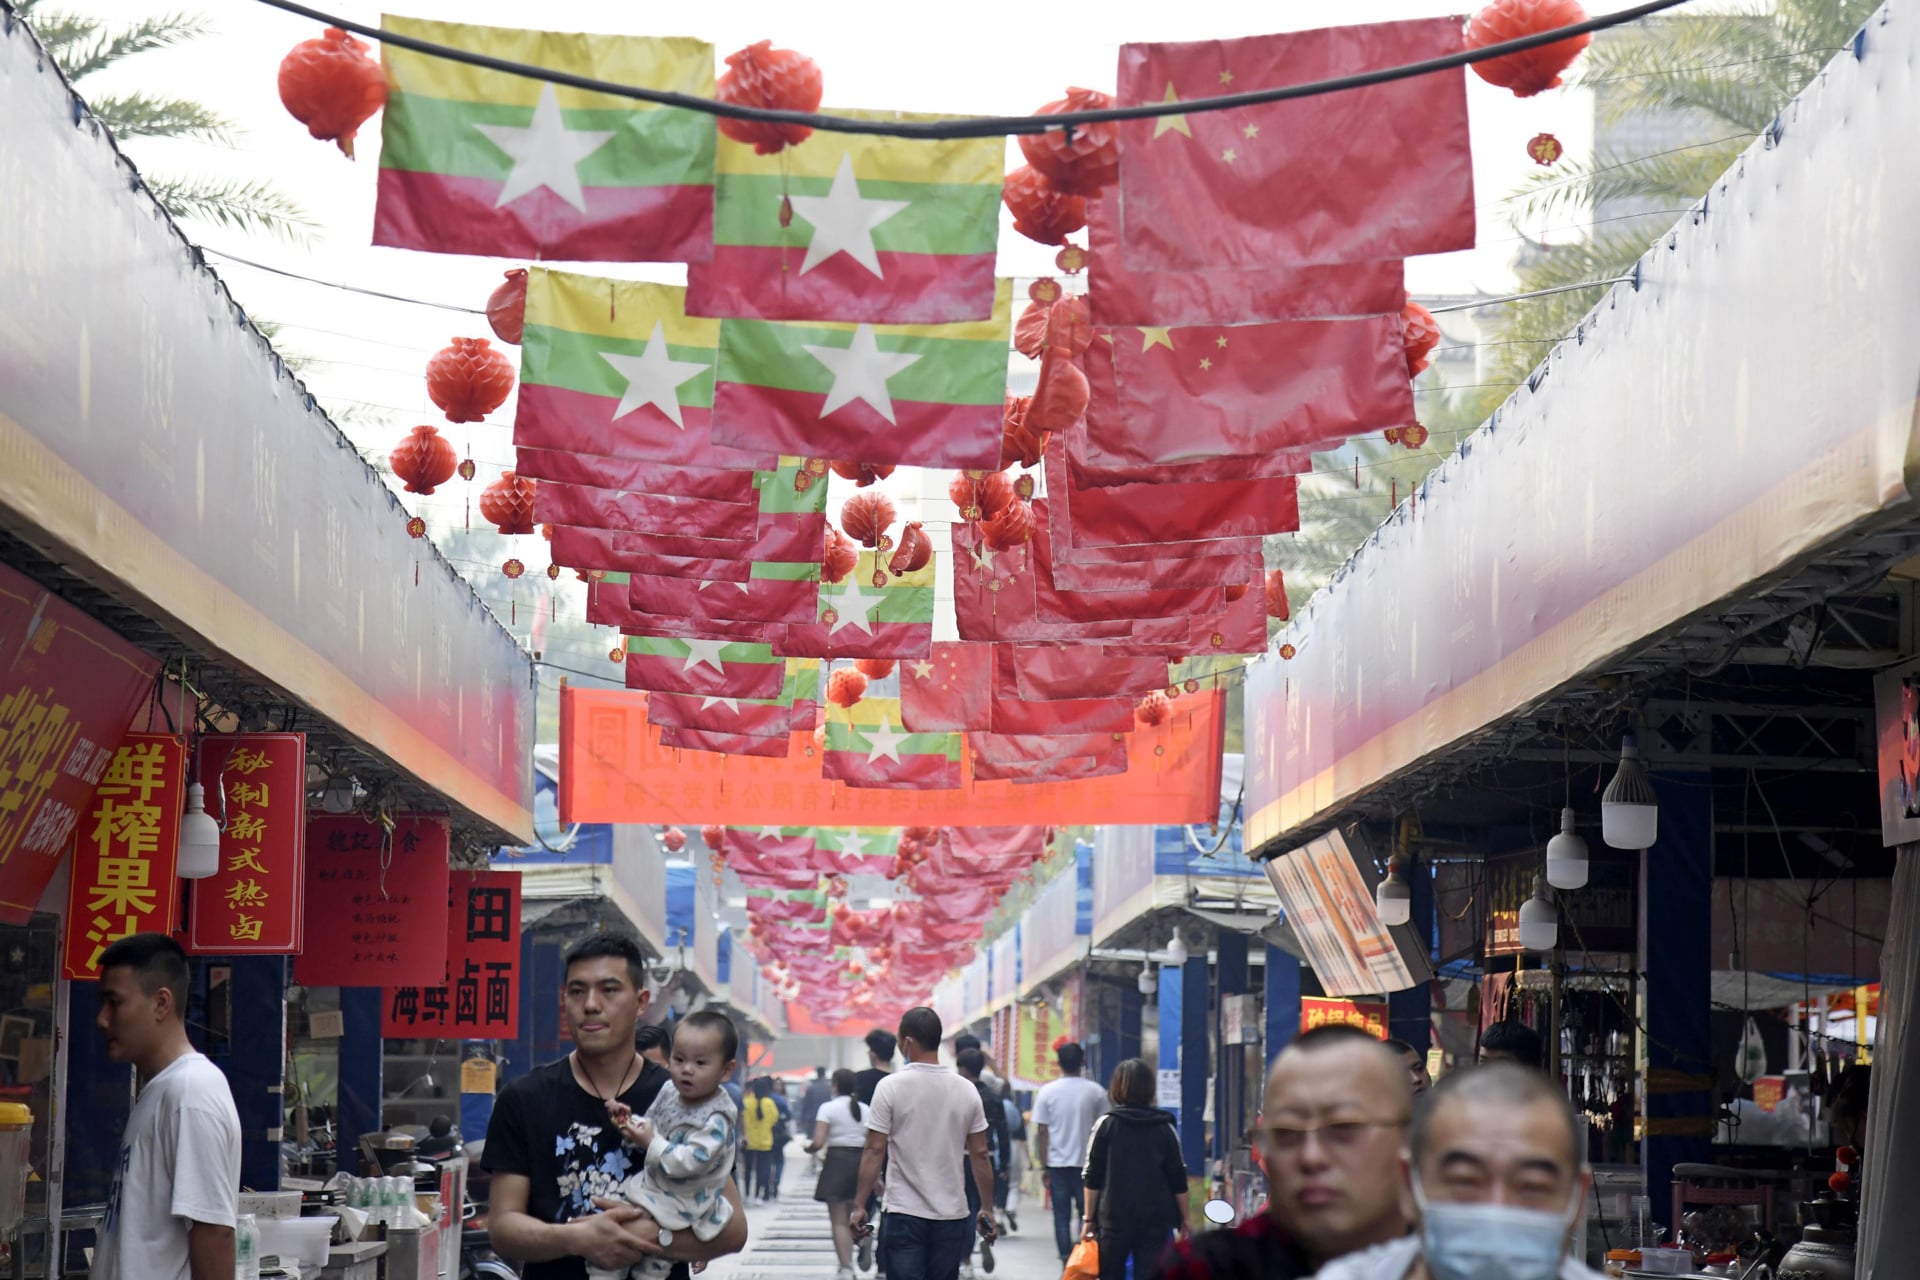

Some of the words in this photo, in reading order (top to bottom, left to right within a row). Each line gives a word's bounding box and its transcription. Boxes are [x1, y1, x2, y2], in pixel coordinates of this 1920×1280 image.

[1534, 138, 1556, 160] 福
[411, 521, 423, 534] 福
[85, 743, 166, 972] 鲜榨果汁
[224, 748, 274, 941] 秘制新式热卤
